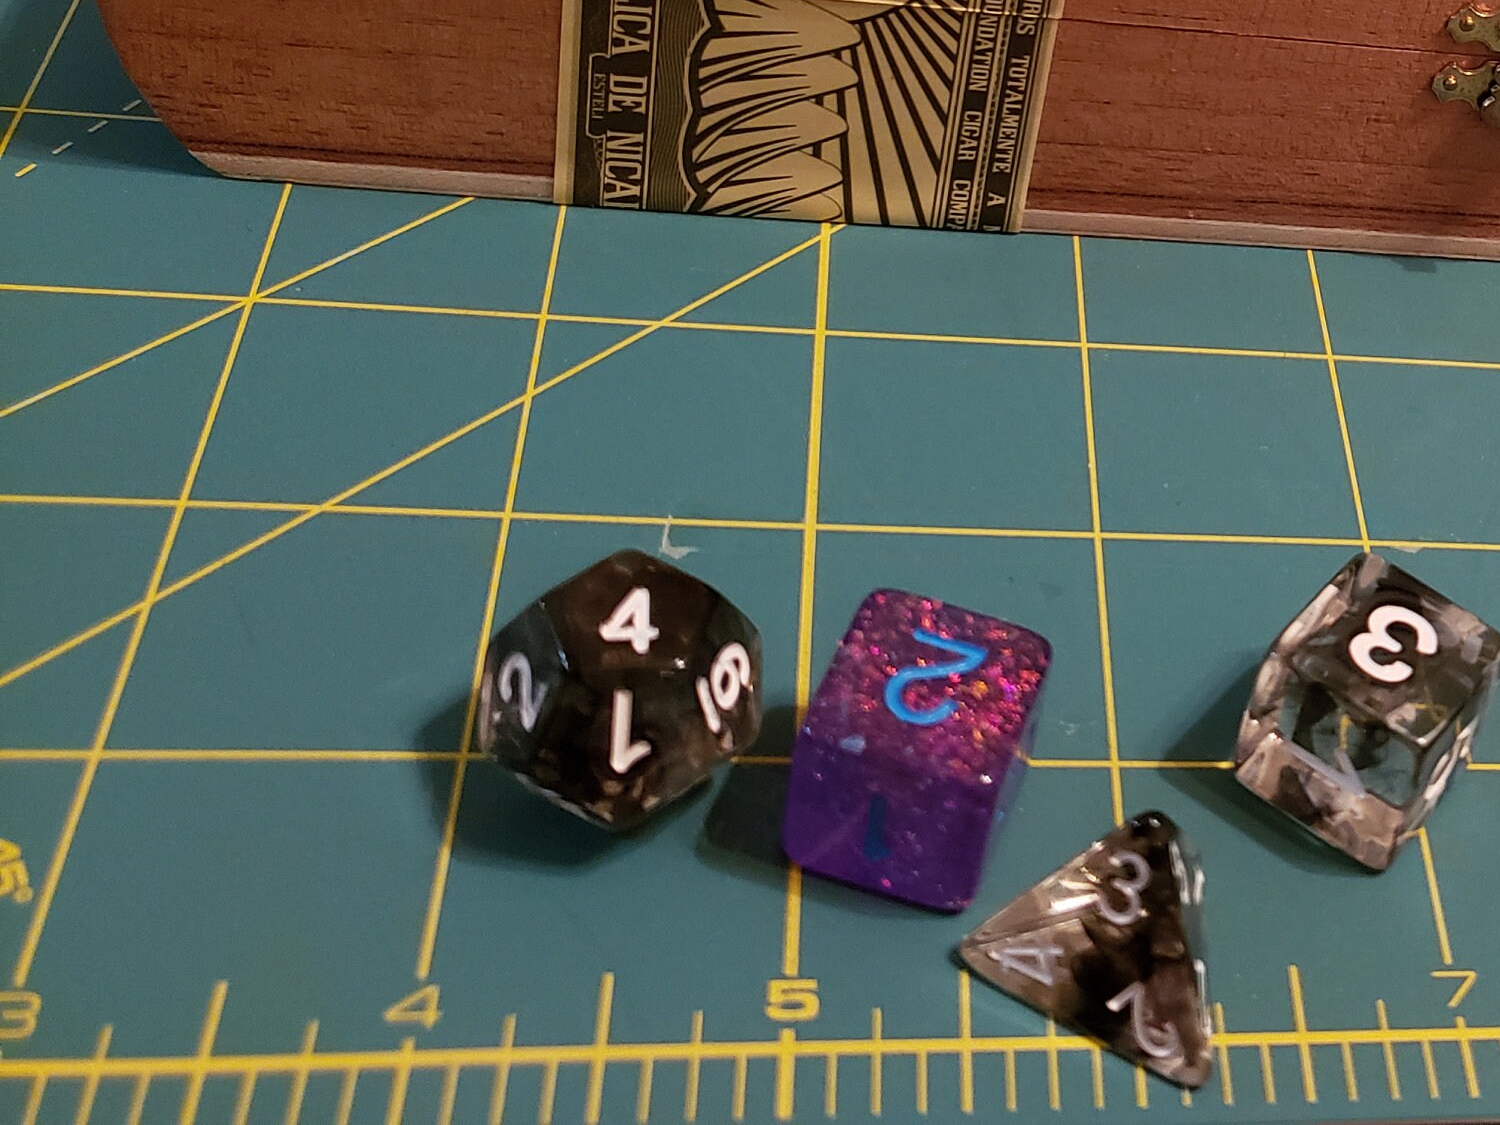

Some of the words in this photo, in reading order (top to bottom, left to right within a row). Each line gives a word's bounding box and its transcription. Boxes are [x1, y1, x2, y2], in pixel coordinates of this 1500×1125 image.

[608, 73, 649, 115] DE
[992, 55, 1031, 174] TOTALMENTE
[957, 111, 982, 161] CIGAR
[987, 192, 1006, 207] A
[598, 586, 661, 655] 4
[1348, 603, 1439, 683] 3
[499, 651, 549, 734] 2
[884, 627, 989, 725] 2
[609, 688, 652, 774] 1
[1096, 850, 1150, 925] 3
[382, 984, 443, 1031] 4
[764, 979, 821, 1021] 5
[1431, 970, 1478, 1008] 7
[994, 946, 1065, 987] 4
